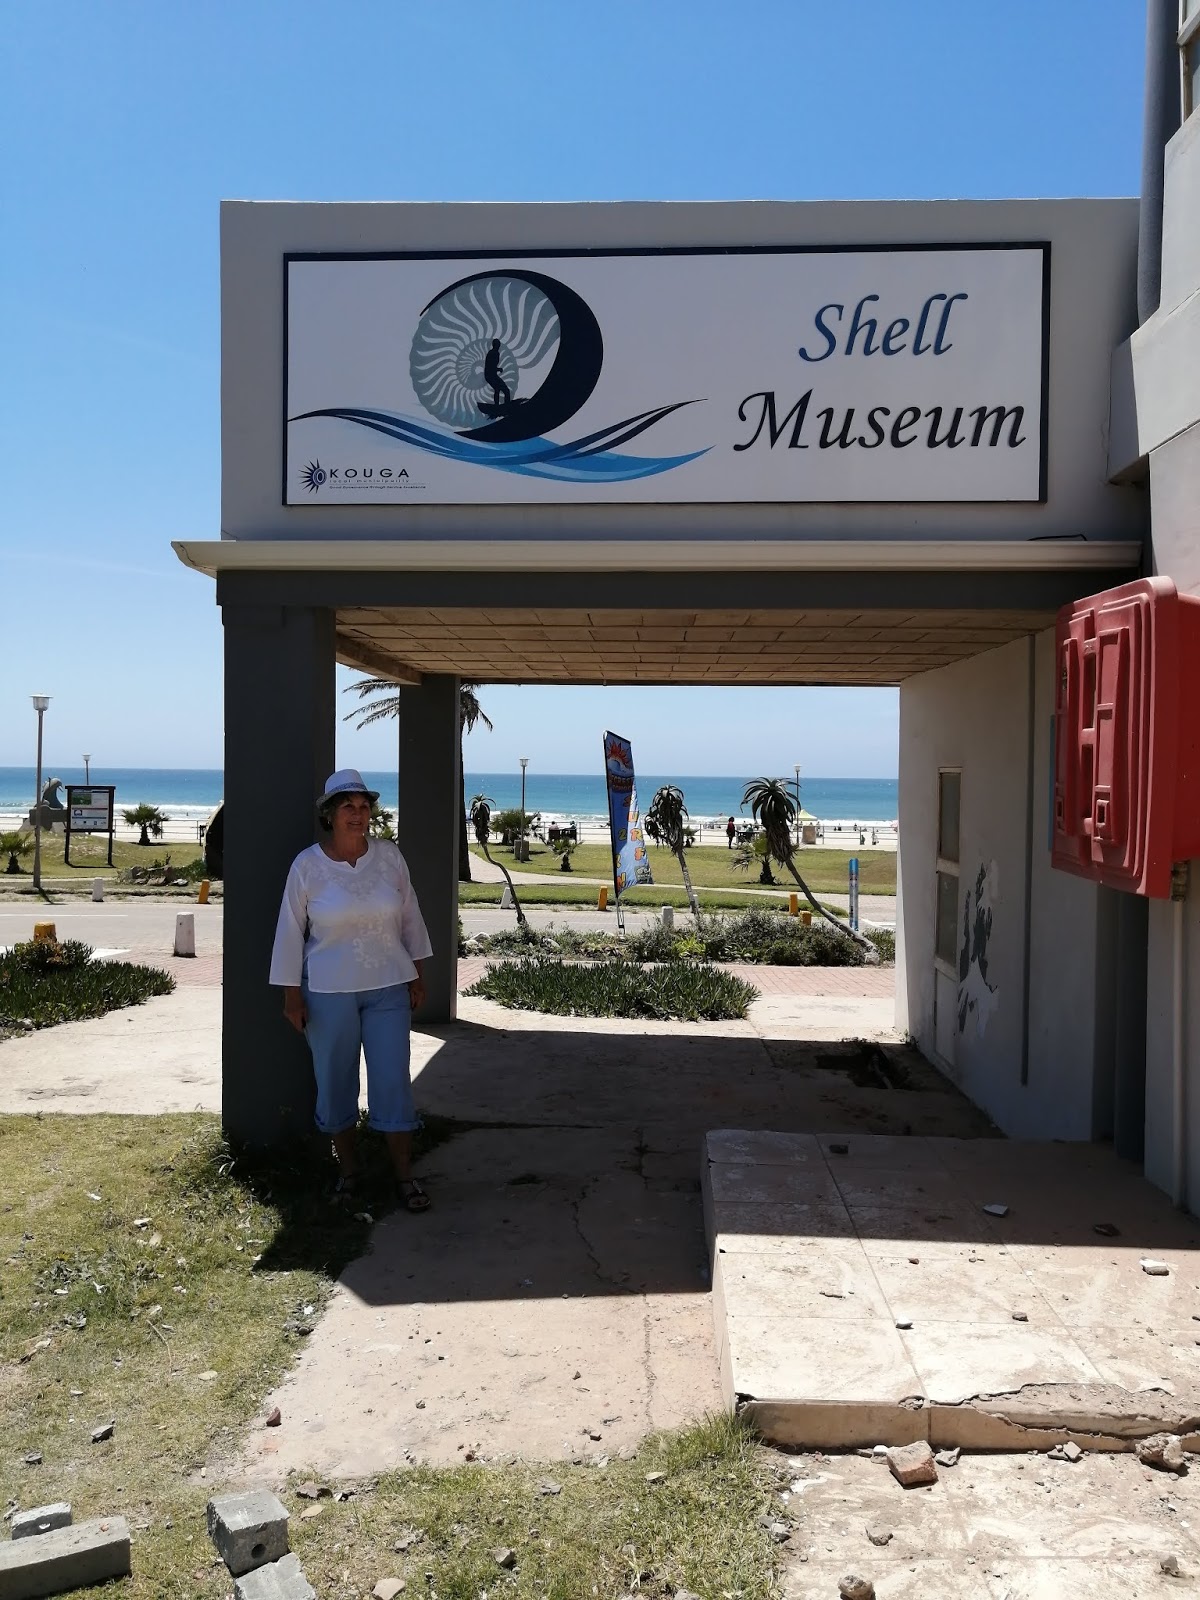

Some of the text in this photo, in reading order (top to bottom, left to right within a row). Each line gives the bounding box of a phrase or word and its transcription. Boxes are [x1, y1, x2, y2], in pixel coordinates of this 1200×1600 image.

[798, 293, 968, 362] Shell
[733, 388, 1026, 451] Museum
[330, 468, 409, 478] KOUGA
